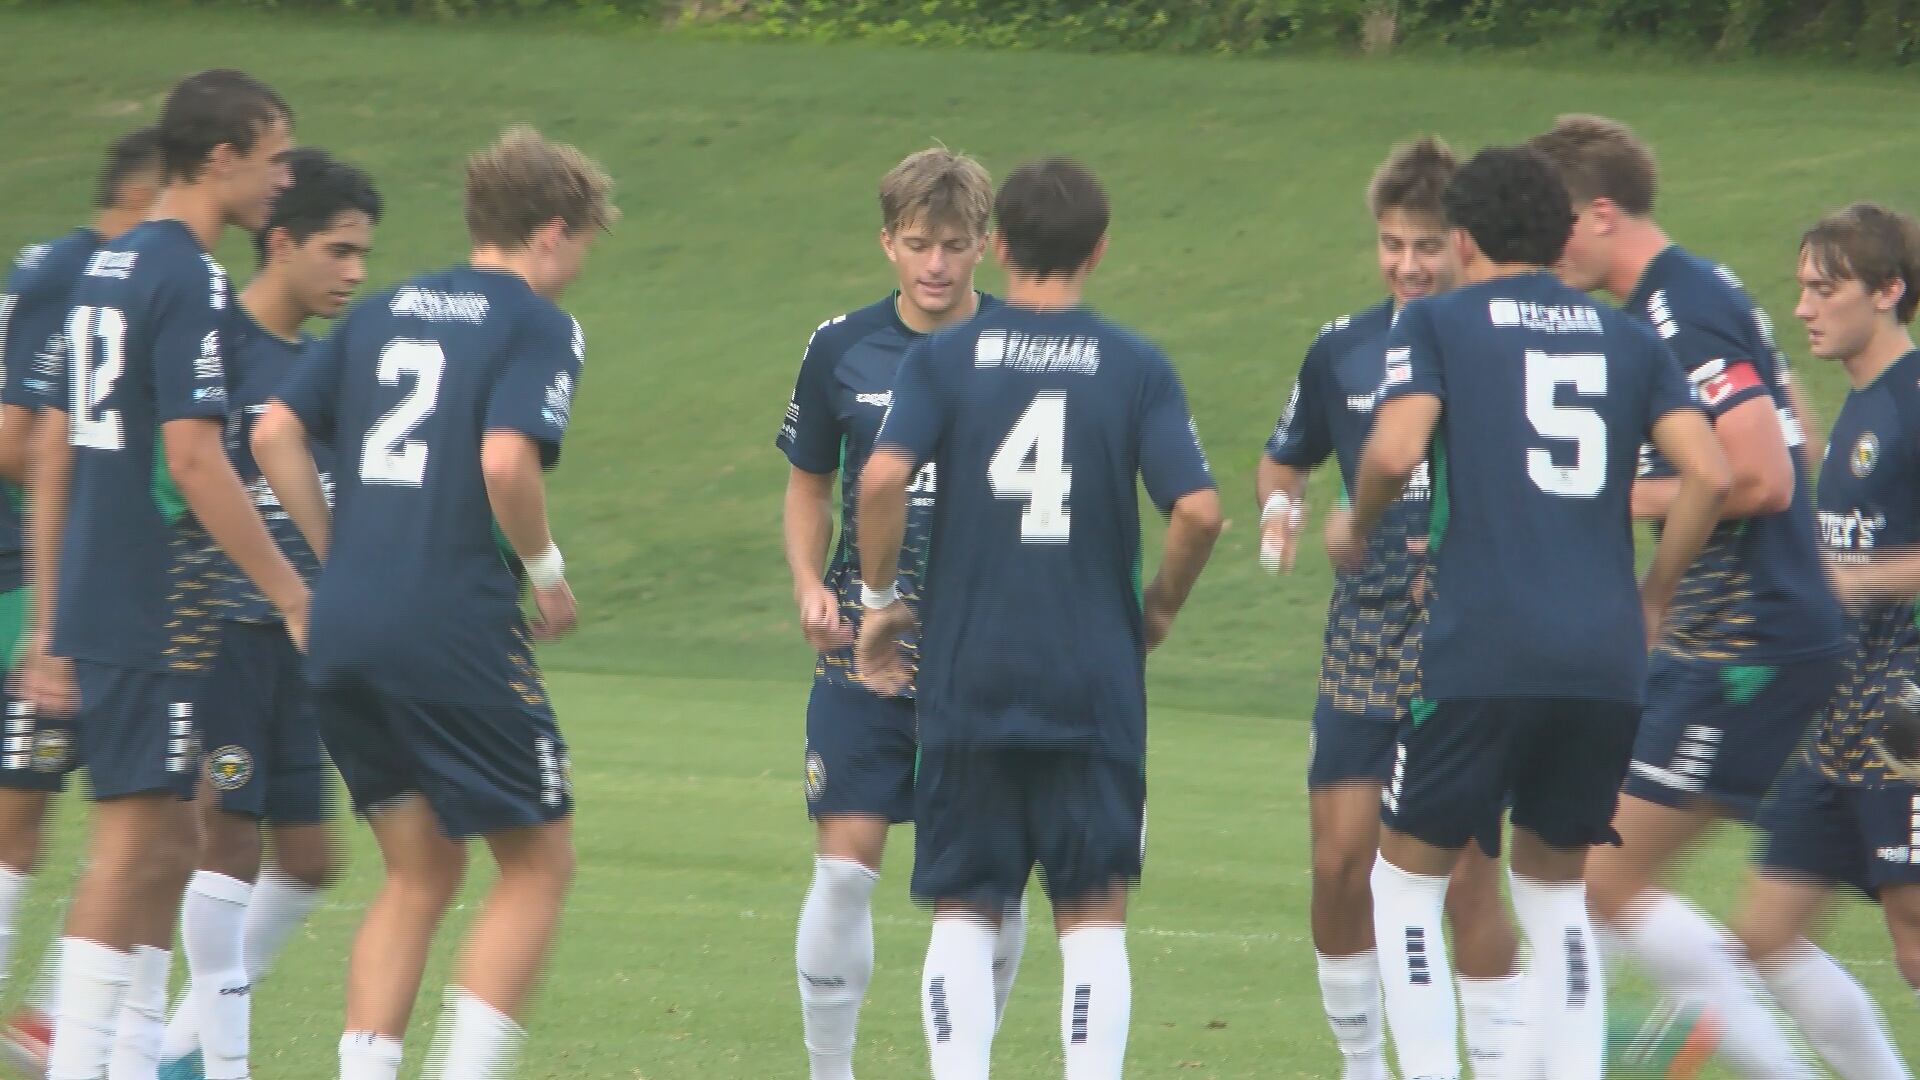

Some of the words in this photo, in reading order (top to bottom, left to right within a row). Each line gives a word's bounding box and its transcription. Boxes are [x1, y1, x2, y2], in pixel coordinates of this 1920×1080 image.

[358, 337, 446, 488] 2
[987, 390, 1073, 545] 4
[1524, 349, 1608, 498] 5
